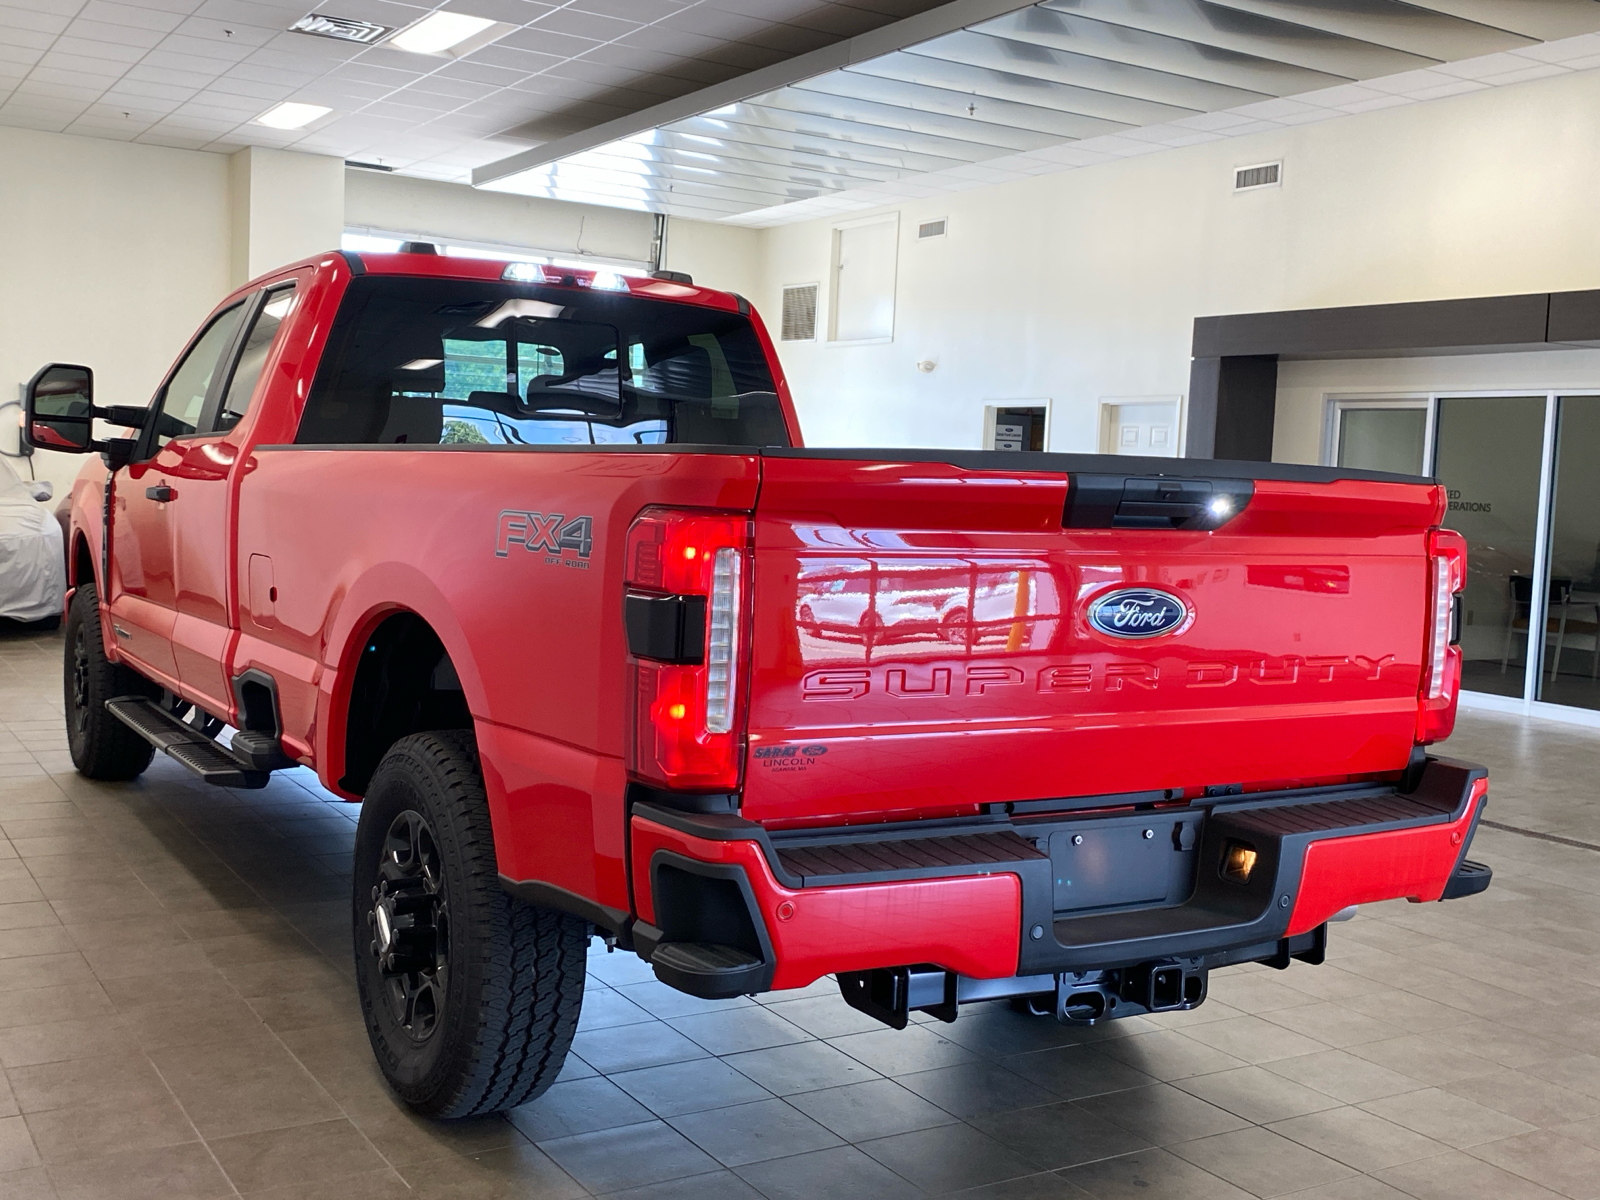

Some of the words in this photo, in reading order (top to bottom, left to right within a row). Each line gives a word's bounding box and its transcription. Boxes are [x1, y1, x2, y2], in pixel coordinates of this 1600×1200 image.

[495, 509, 593, 559] FX4
[544, 557, 562, 565] OFF
[565, 560, 590, 570] ROAD
[1114, 599, 1167, 627] Ford
[801, 662, 1159, 702] SUPER
[1186, 654, 1396, 689] DUTY
[754, 746, 799, 758] SARAT
[763, 757, 815, 767] LINCOLN
